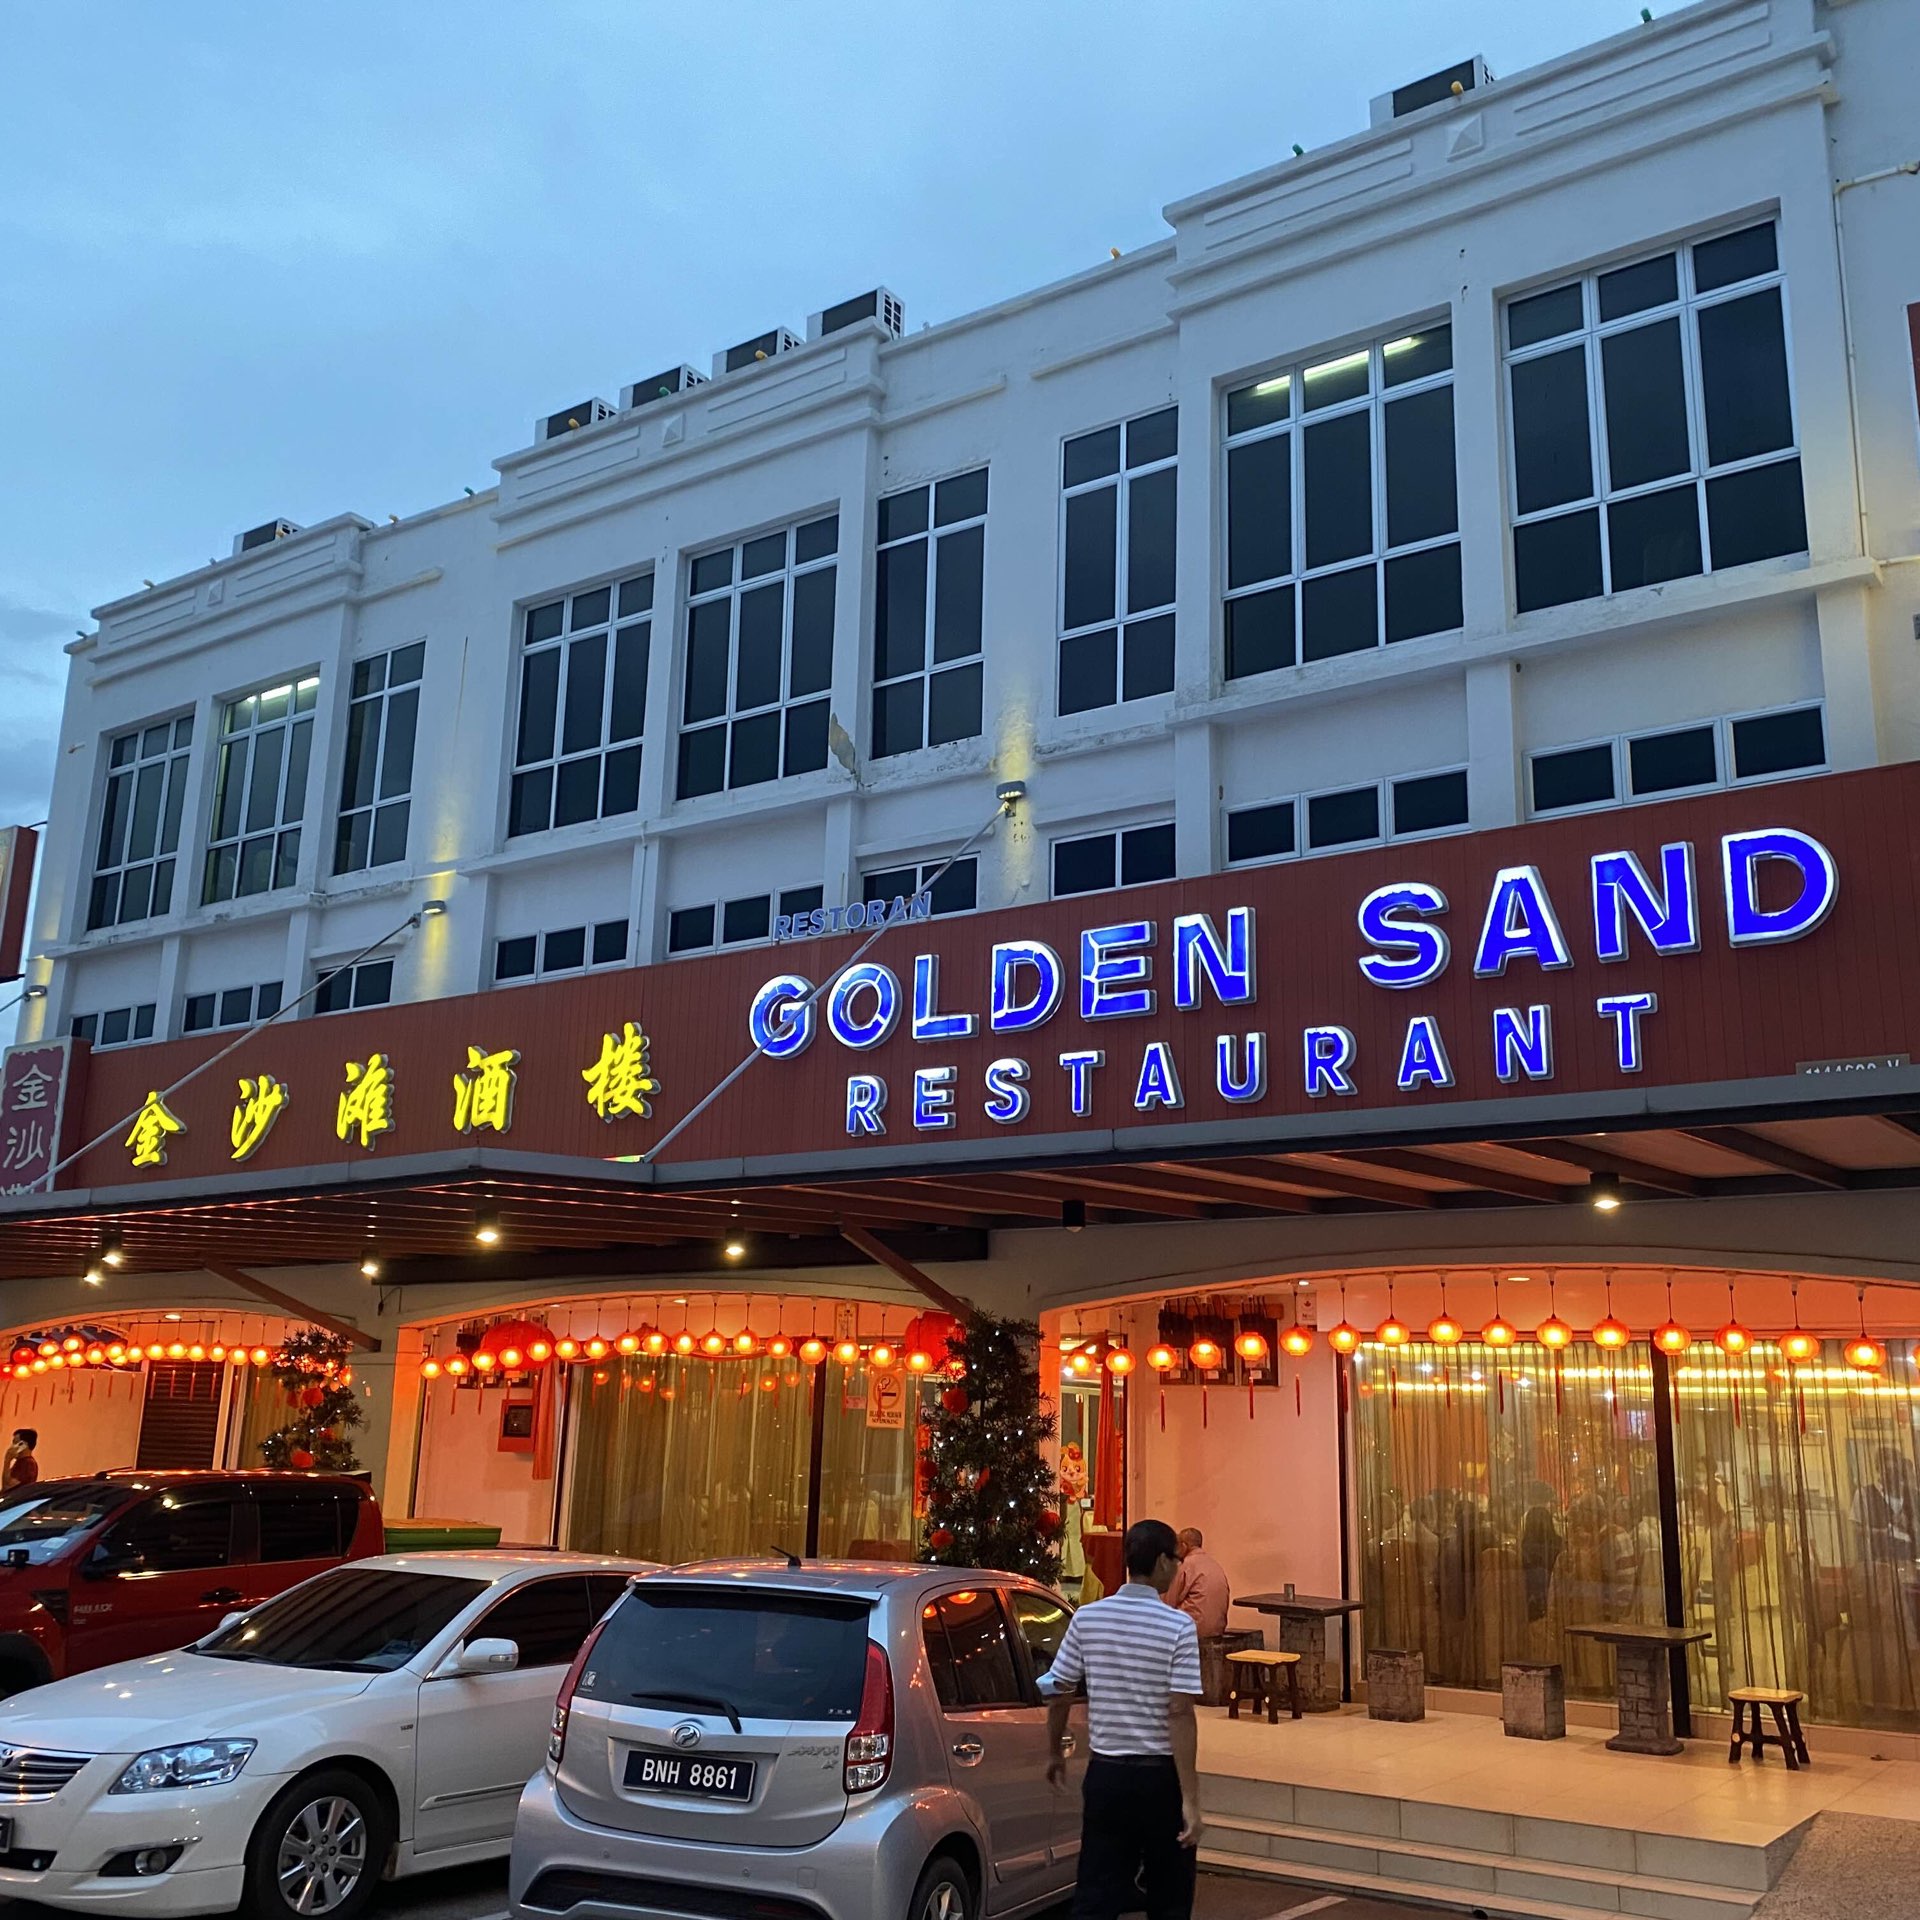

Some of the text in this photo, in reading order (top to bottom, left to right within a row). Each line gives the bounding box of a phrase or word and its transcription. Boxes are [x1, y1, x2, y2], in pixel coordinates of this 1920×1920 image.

[749, 827, 1839, 1060] GOLDEN SAND
[774, 891, 932, 941] RESTORAN
[2, 1063, 52, 1195] 金沙
[845, 991, 1659, 1137] RESTAURANT
[642, 1758, 737, 1790] BNH 8861
